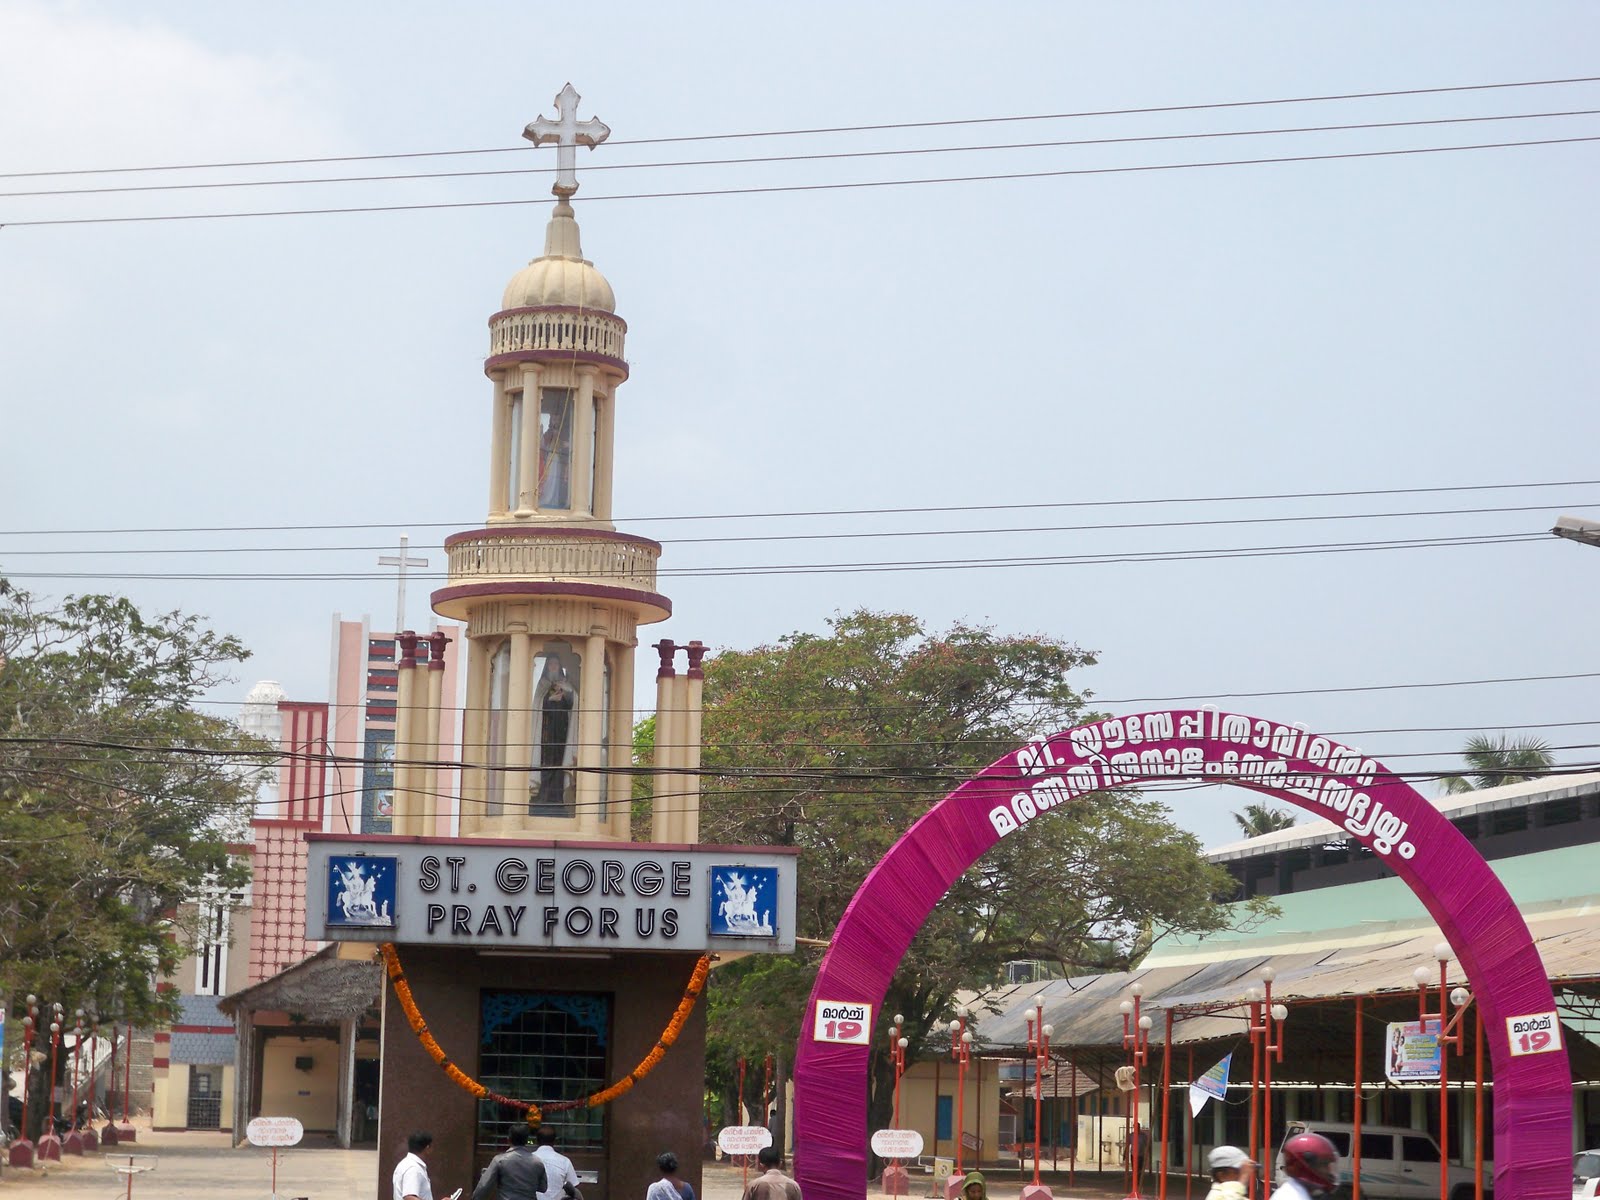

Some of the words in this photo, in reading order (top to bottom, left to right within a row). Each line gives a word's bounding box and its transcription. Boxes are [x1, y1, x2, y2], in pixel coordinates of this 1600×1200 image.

[1017, 735, 1065, 776] വി.
[419, 856, 477, 892] ST.
[495, 858, 691, 896] GEORGE
[427, 903, 526, 935] PRAY
[543, 906, 619, 937] FOR
[636, 908, 679, 937] US
[822, 1006, 864, 1020] മാർച്ച്
[824, 1020, 863, 1040] 19
[1513, 1015, 1551, 1033] മാർച്ച്
[1518, 1031, 1552, 1052] 19
